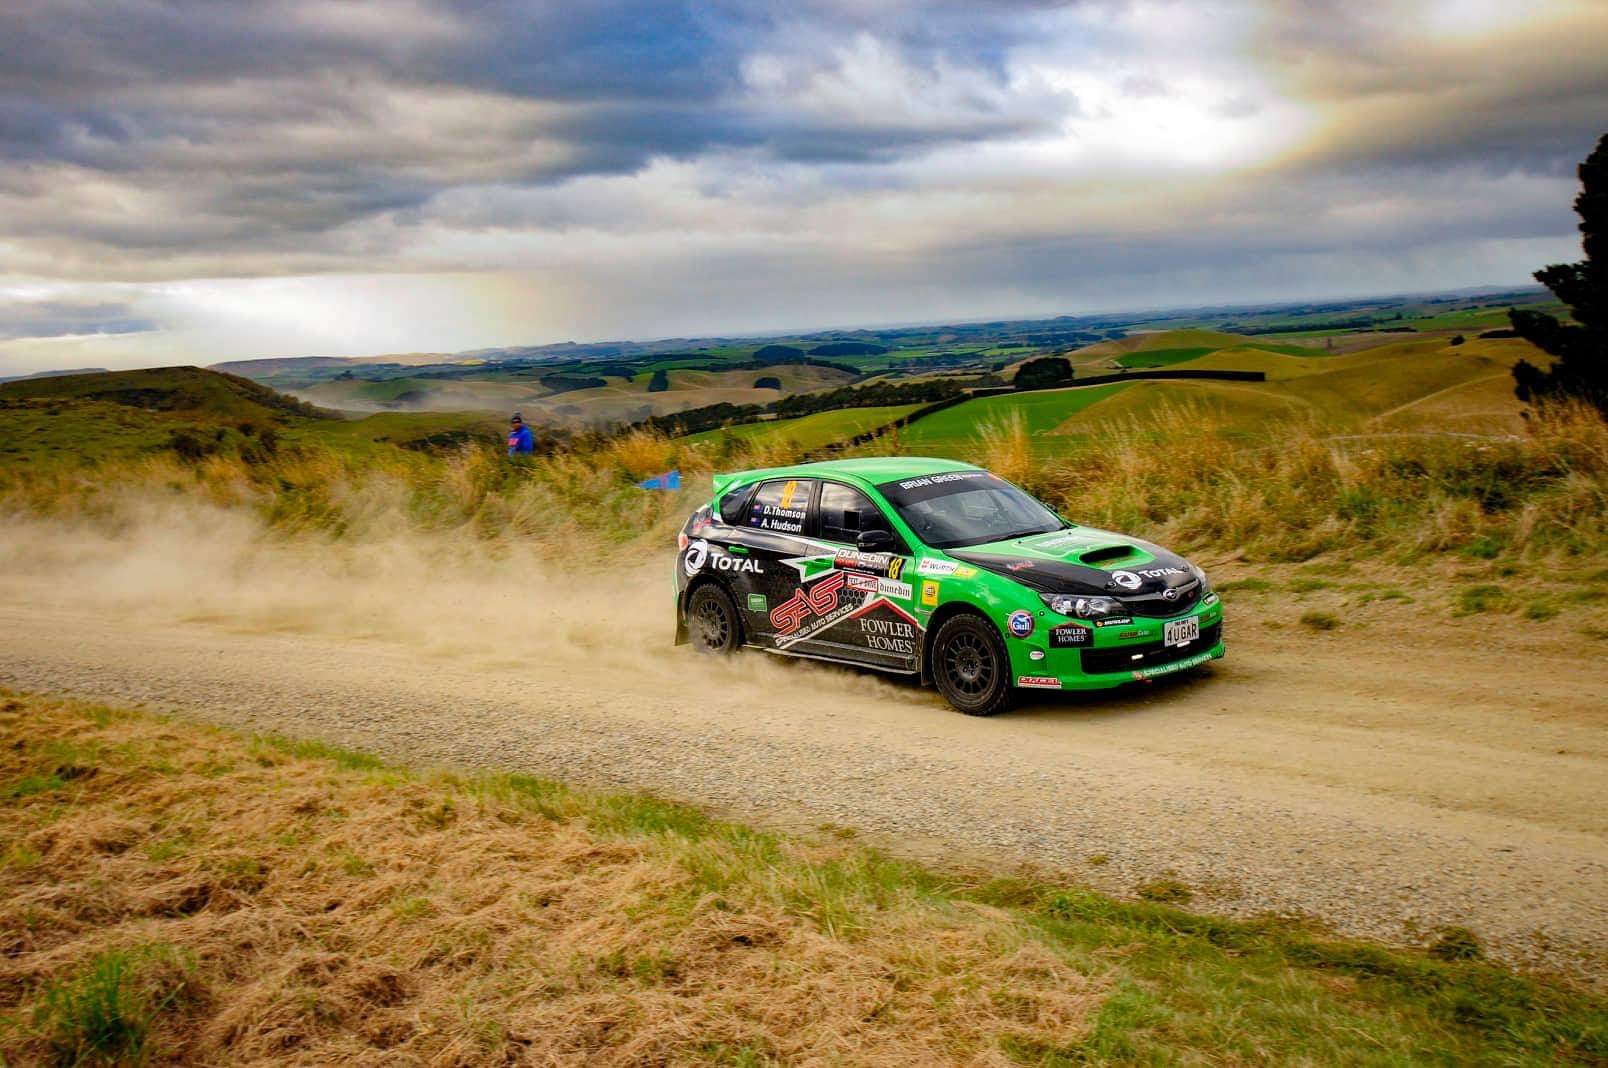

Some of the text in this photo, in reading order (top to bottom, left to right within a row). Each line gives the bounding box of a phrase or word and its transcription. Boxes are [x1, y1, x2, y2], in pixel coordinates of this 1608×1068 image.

[899, 479, 933, 490] BRIAN
[931, 474, 963, 484] GREEN
[770, 519, 802, 533] Hudson
[711, 553, 764, 574] TOTAL
[838, 549, 889, 566] DUNEDIN
[888, 558, 903, 580] 18
[1138, 566, 1184, 579] TOTAL
[879, 582, 911, 598] dunedin
[810, 617, 826, 631] AUTO
[825, 602, 854, 620] SERVICES
[860, 618, 915, 639] FOWLER
[1012, 621, 1030, 631] Gull
[1055, 628, 1087, 636] FOWLER
[866, 634, 913, 654] HOMES
[1057, 635, 1085, 643] HOMES
